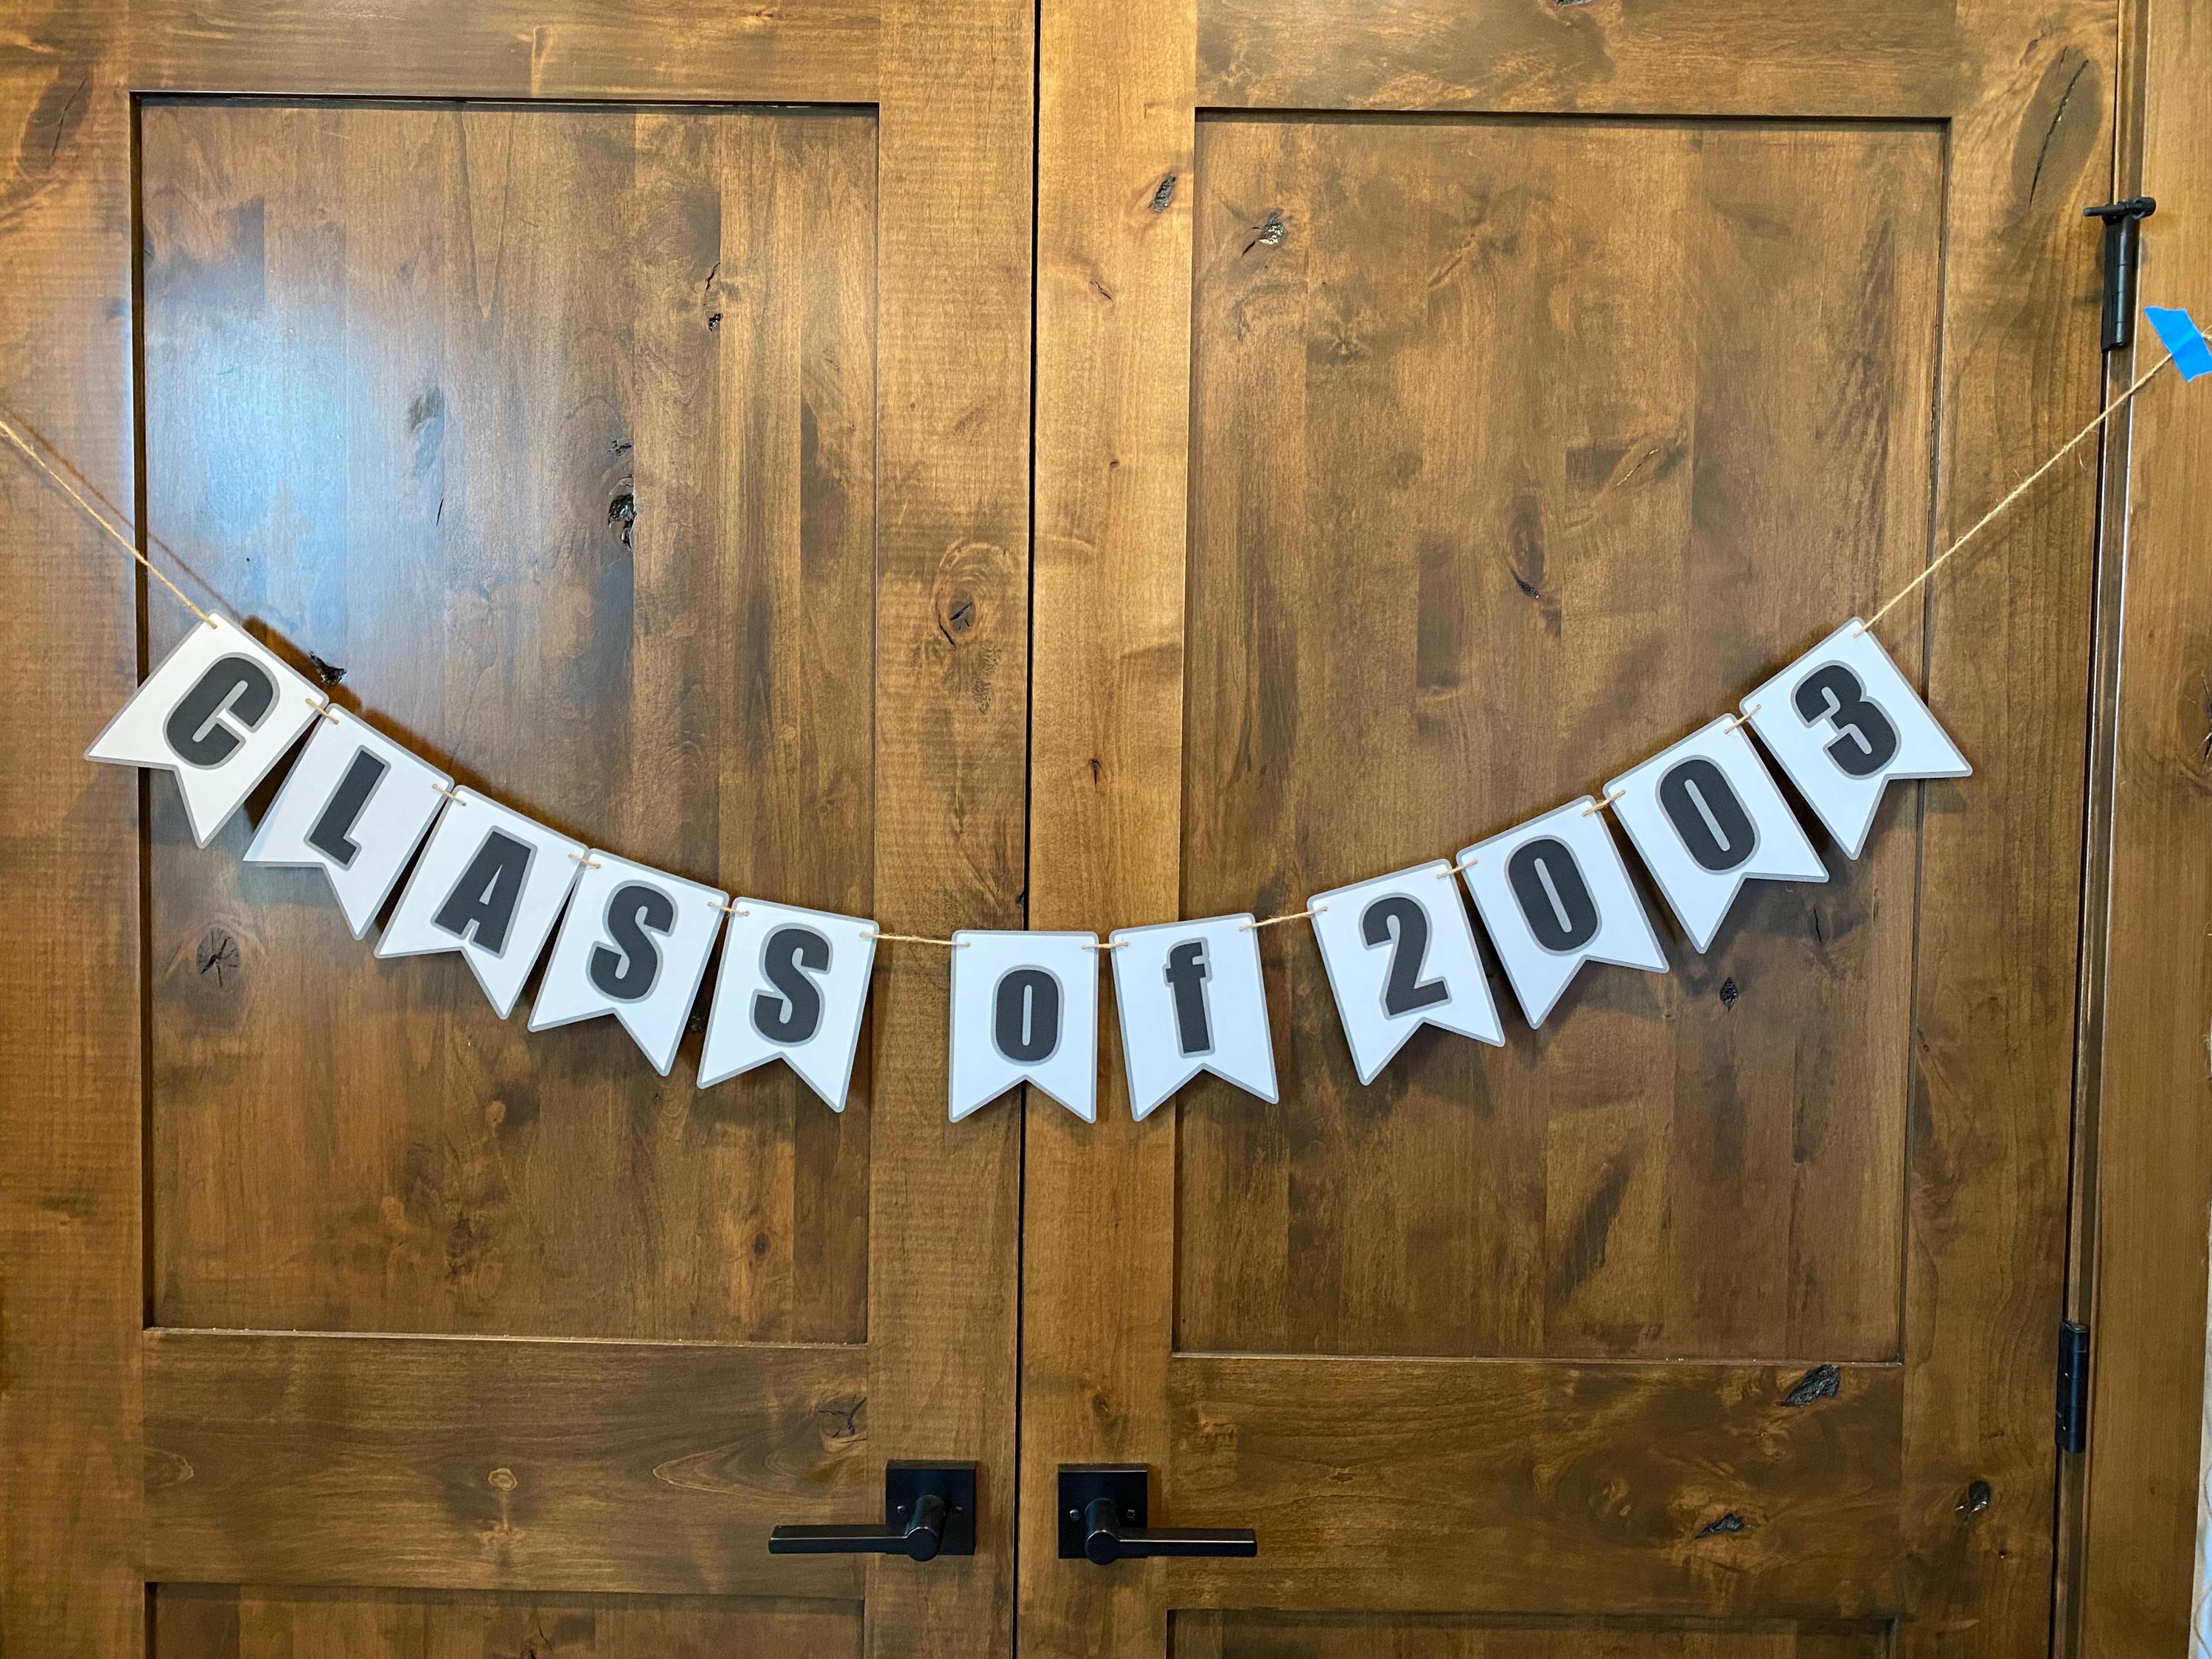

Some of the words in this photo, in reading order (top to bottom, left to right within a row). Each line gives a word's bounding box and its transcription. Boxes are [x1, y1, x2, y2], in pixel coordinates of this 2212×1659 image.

[165, 655, 831, 1045] CLASS
[995, 940, 1211, 1063] of
[1361, 664, 1898, 1018] 2003
